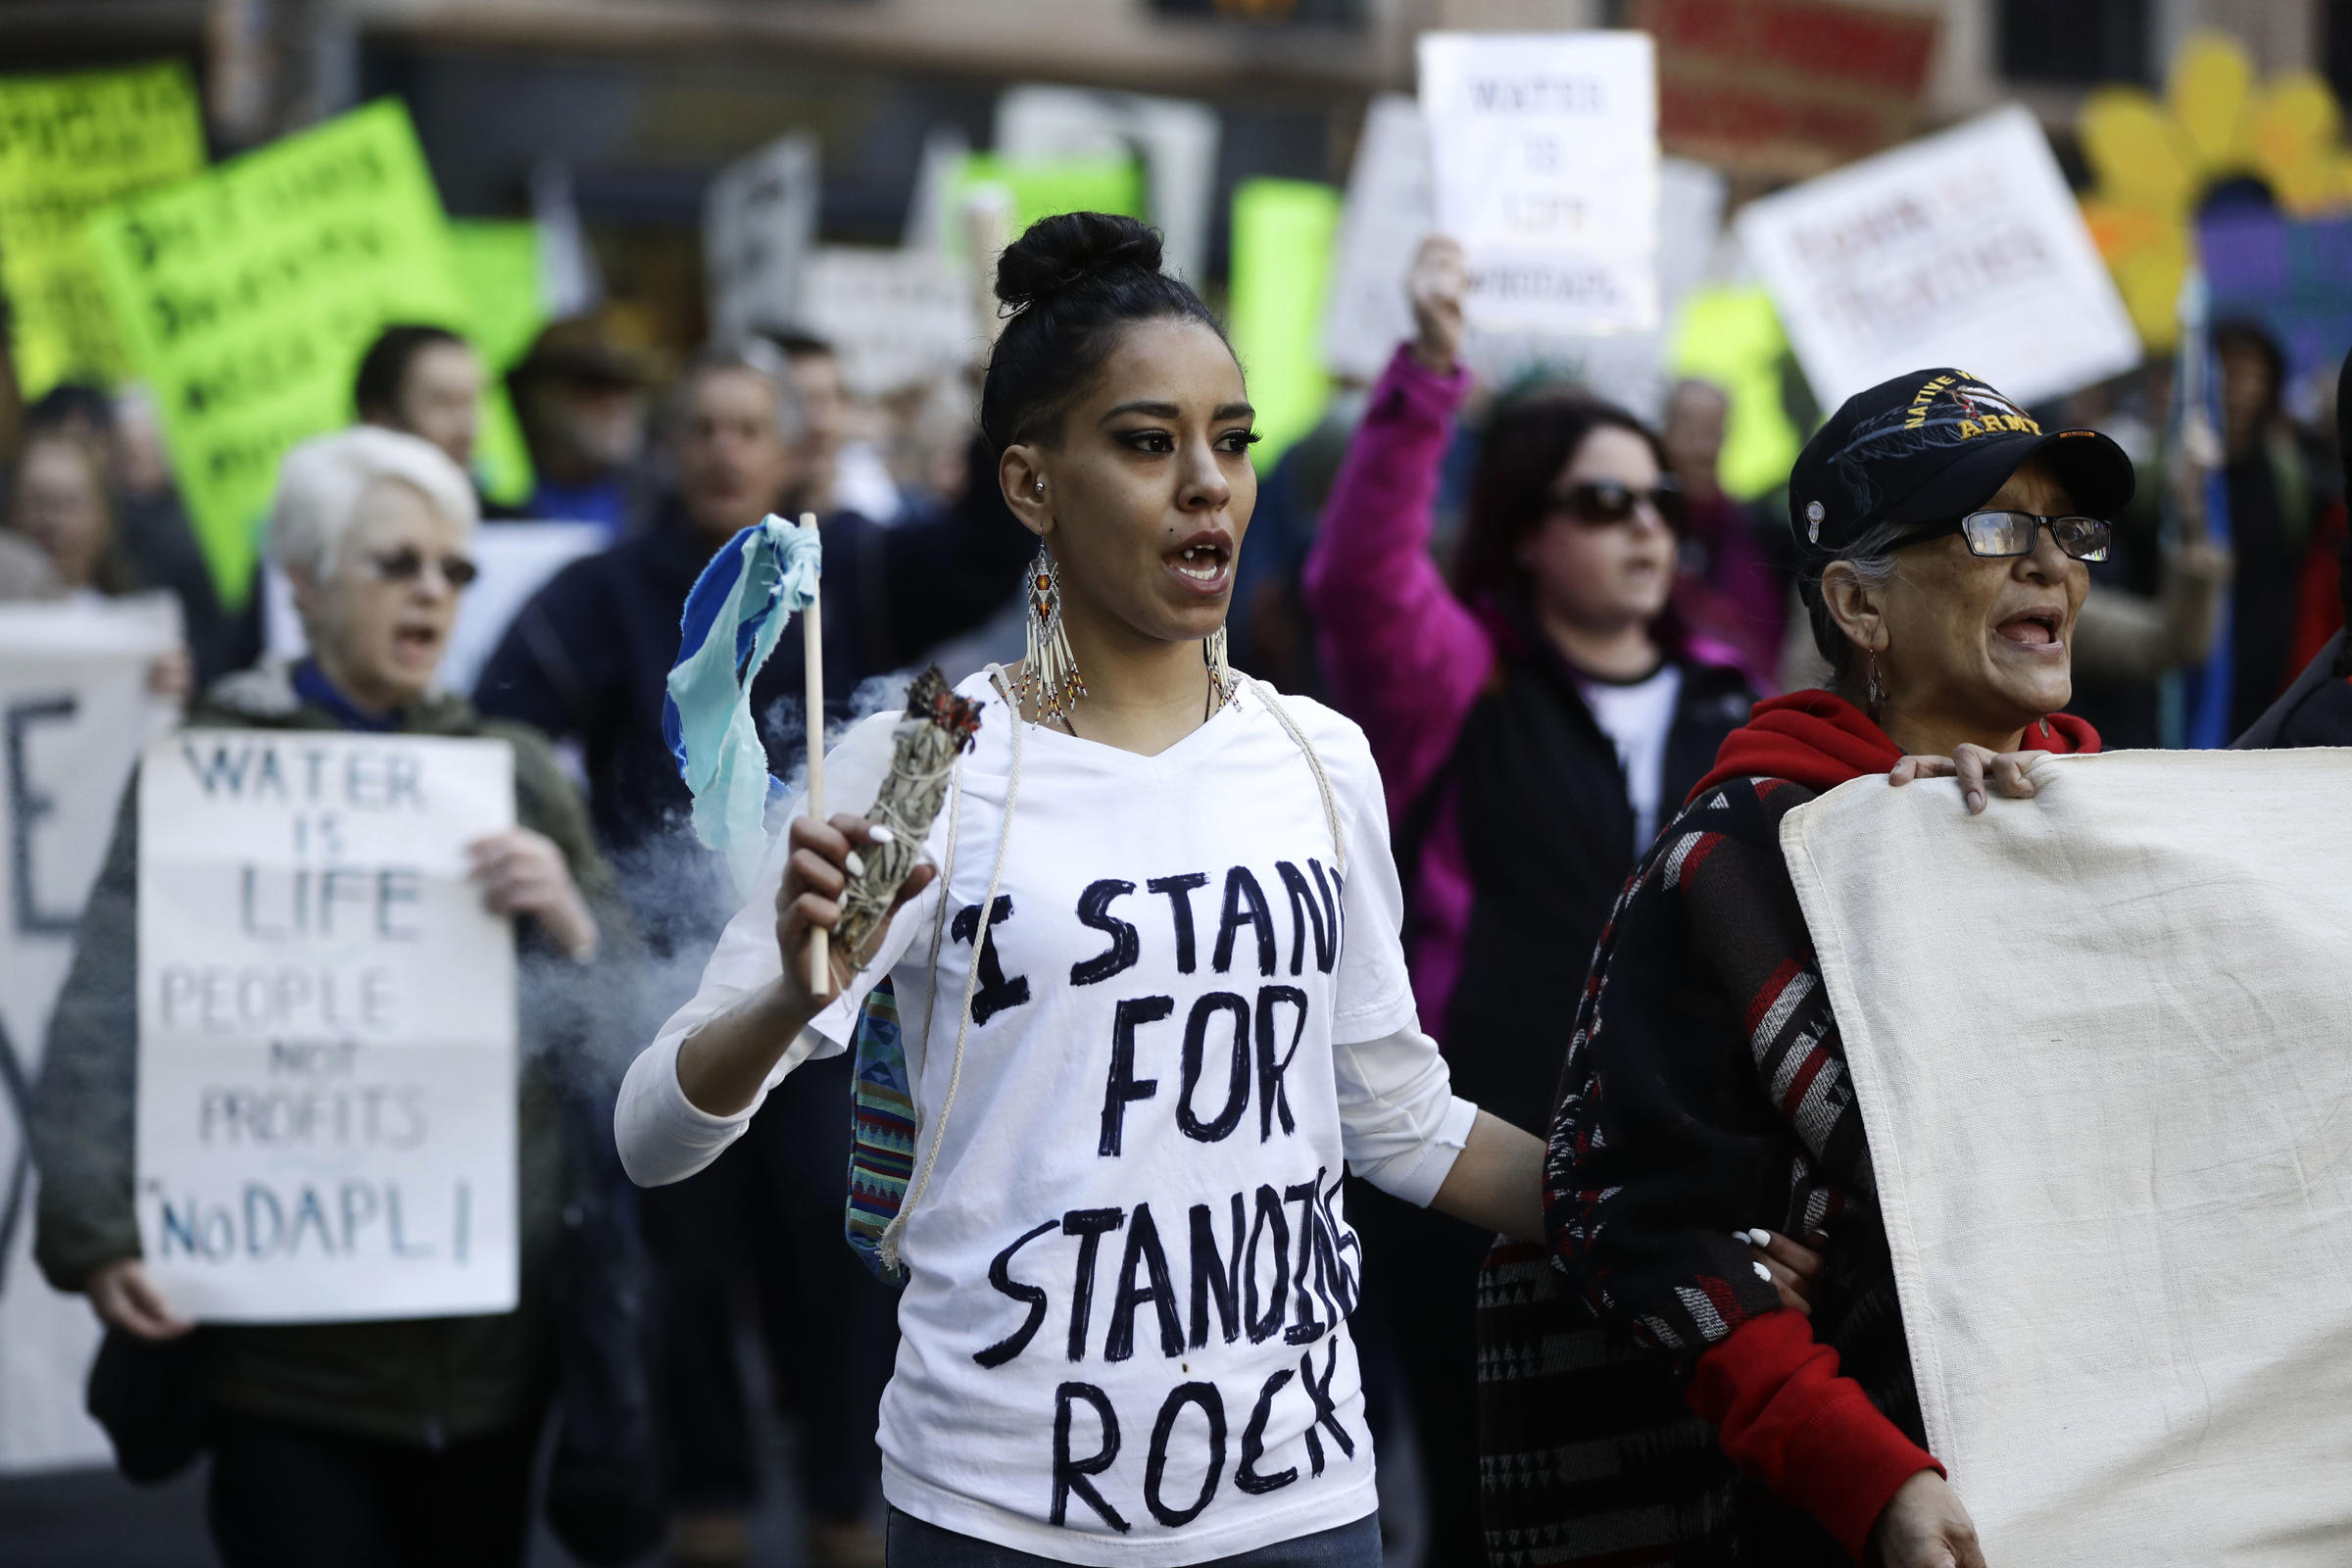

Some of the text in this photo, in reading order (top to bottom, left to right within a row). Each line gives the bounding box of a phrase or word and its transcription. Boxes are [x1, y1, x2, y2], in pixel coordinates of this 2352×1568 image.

[1904, 375, 1956, 429] NATIVE
[1957, 414, 2042, 440] ARMY
[181, 741, 425, 808] WATER
[293, 812, 343, 855] IS
[241, 864, 421, 943] LIFE
[951, 894, 1031, 1028] I
[158, 962, 392, 1032] PEOPLE
[268, 1039, 360, 1074] NOT
[1097, 985, 1308, 1158] FOR
[198, 1084, 429, 1151] PROFITS
[1050, 1334, 1355, 1533] ROCK
